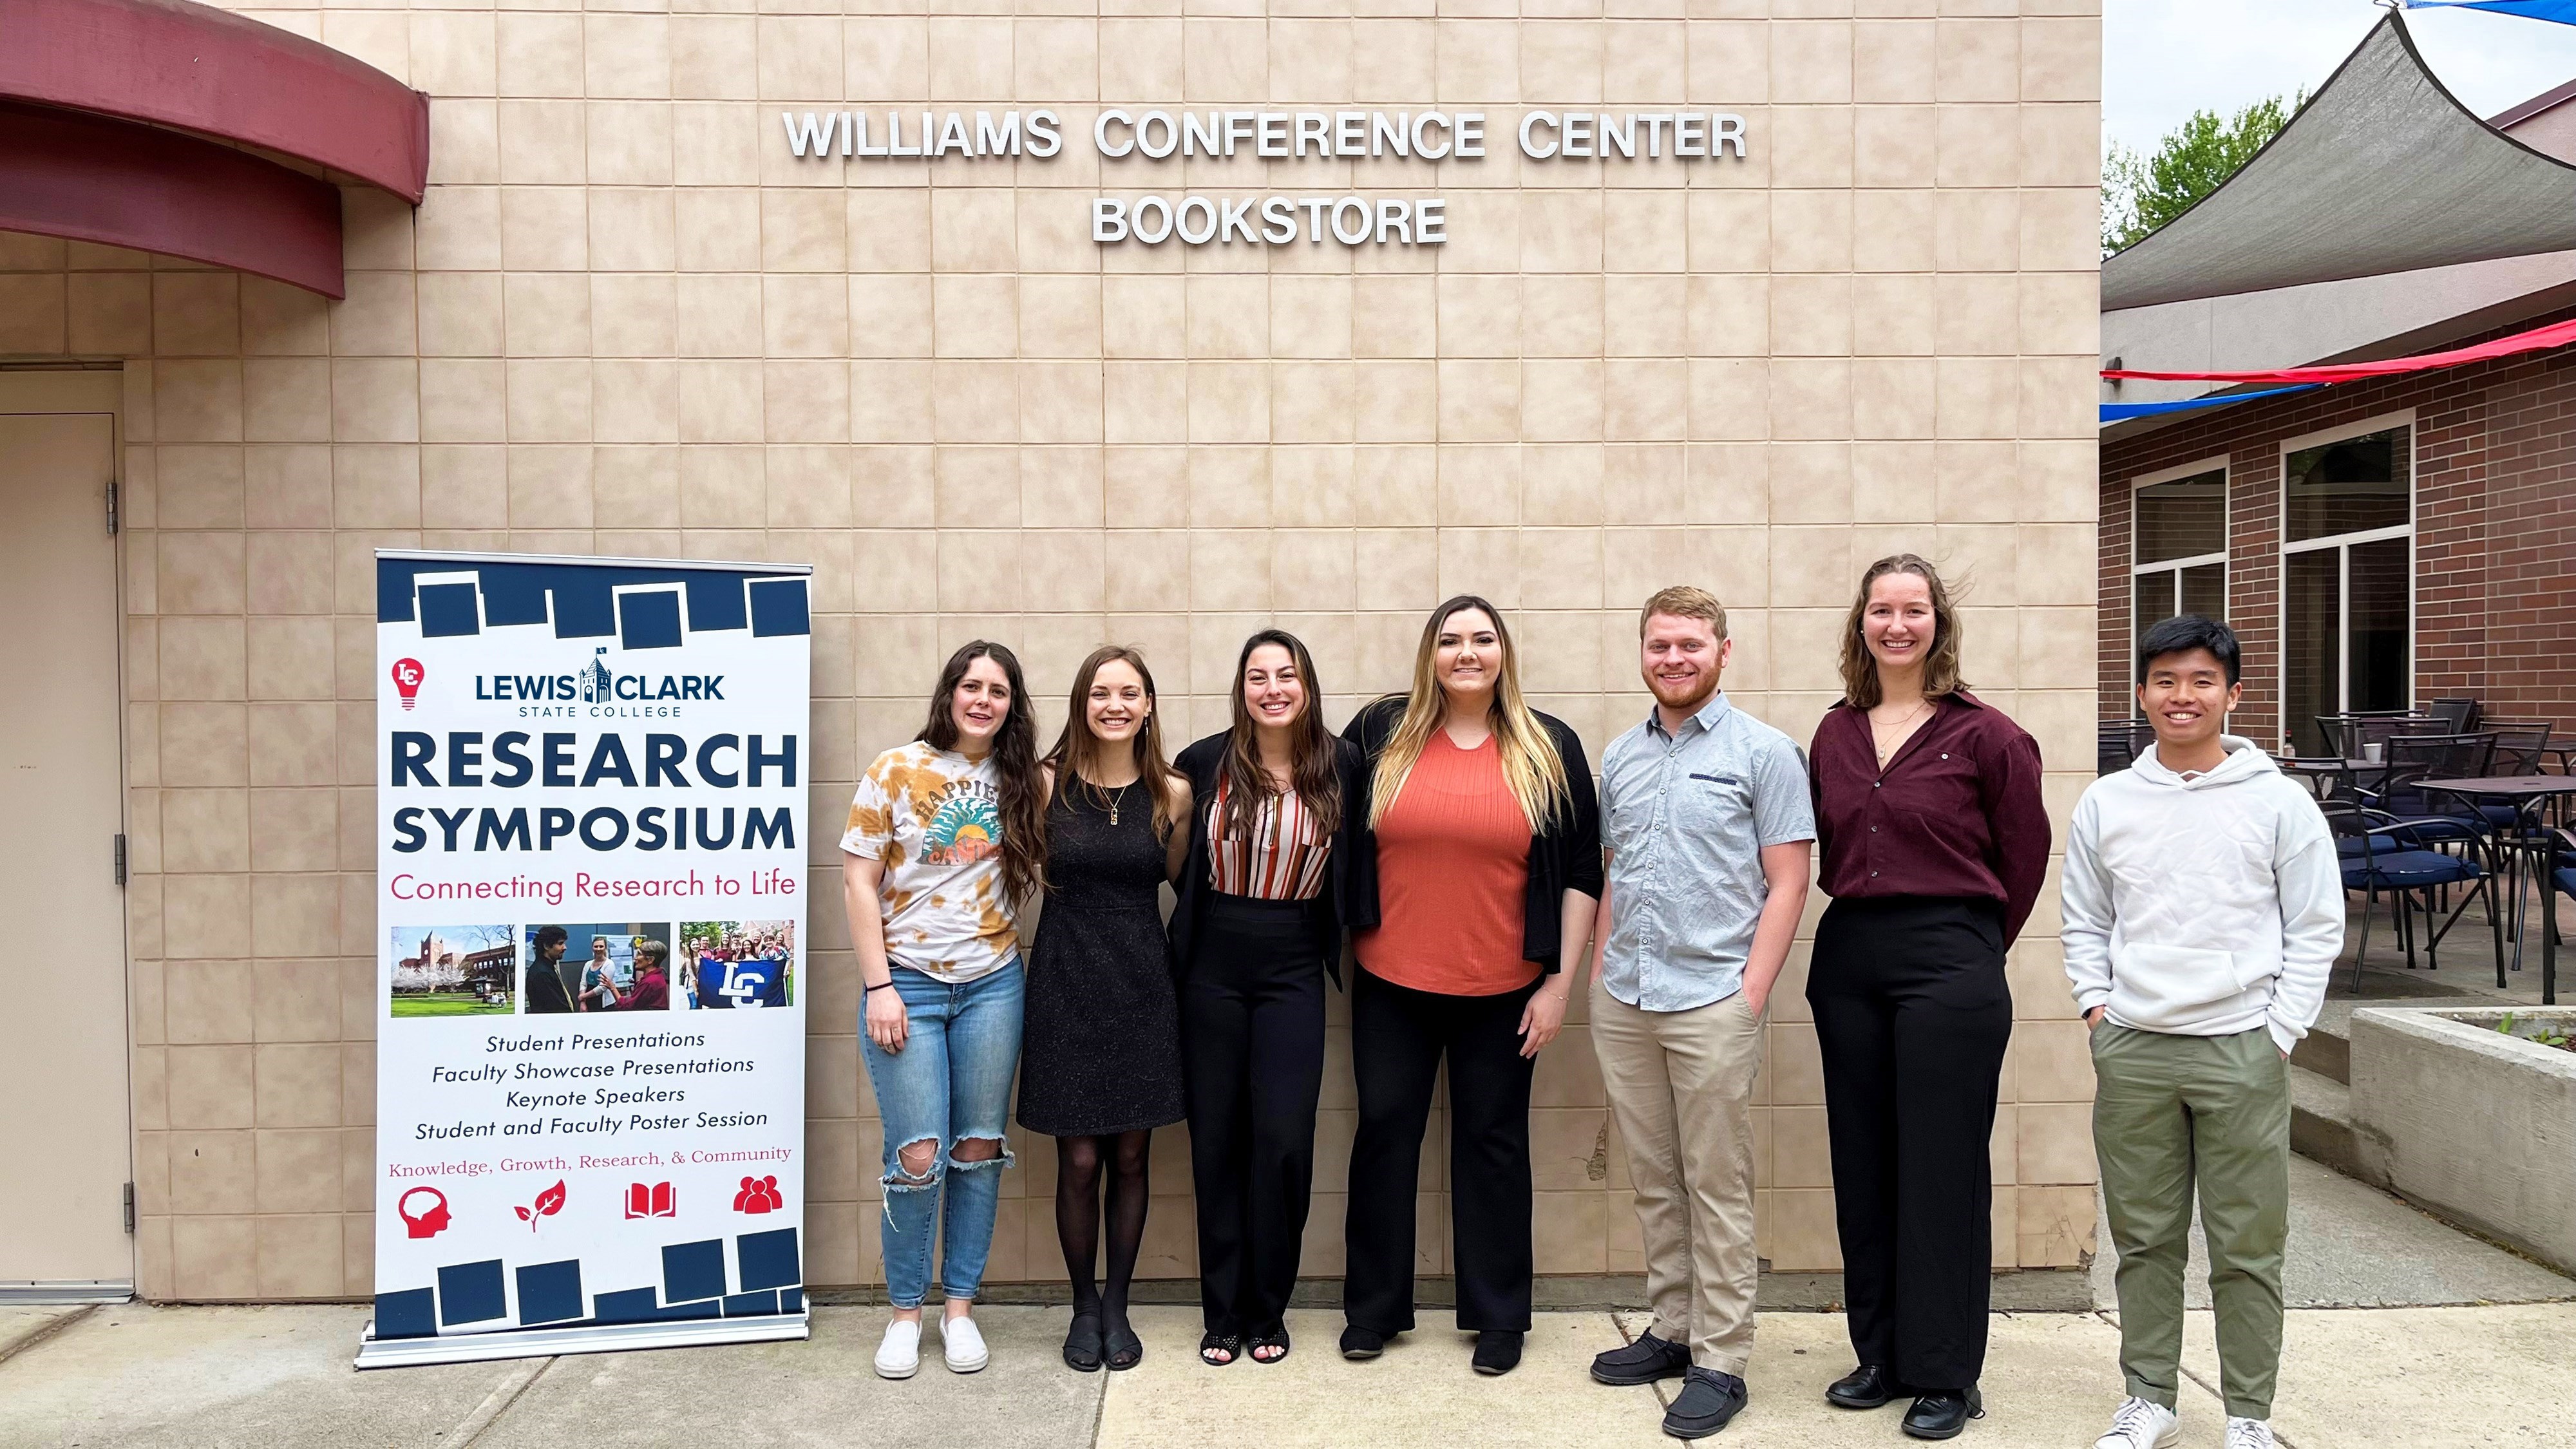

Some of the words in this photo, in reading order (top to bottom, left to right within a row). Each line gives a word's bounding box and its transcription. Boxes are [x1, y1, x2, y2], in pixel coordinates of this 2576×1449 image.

[782, 109, 1061, 157] WILLIAMS
[1094, 109, 1486, 159] CONFERENCE
[1519, 110, 1747, 158] CENTER
[1092, 195, 1447, 245] BOOKSTORE
[475, 676, 576, 700] LEWIS
[615, 676, 725, 700] CLARK
[519, 707, 575, 717] STATE
[590, 707, 680, 717] COLLEGE
[392, 731, 797, 788] RESEARCH
[915, 780, 999, 822] HAPPIE
[392, 807, 795, 853] SYMPOSIUM
[392, 874, 562, 905] Connecting
[577, 869, 703, 896] Research
[715, 875, 740, 895] to
[753, 868, 795, 895] Life
[486, 1035, 564, 1052] Student
[573, 1032, 705, 1050] Presentations
[433, 1064, 507, 1084] Faculty
[514, 1063, 614, 1079] Showcase
[623, 1058, 753, 1075] Presentations
[507, 1092, 586, 1111] Keynote
[594, 1086, 685, 1108] Speakers
[415, 1121, 496, 1139] Student
[504, 1118, 542, 1135] and
[551, 1115, 623, 1135] Faculty
[630, 1115, 690, 1130] Poster
[696, 1112, 767, 1128] Session
[390, 1160, 492, 1177] Knowledge,
[501, 1157, 571, 1171] Growth,
[580, 1152, 664, 1168] Research,
[672, 1151, 685, 1164] &
[692, 1147, 791, 1162] Community
